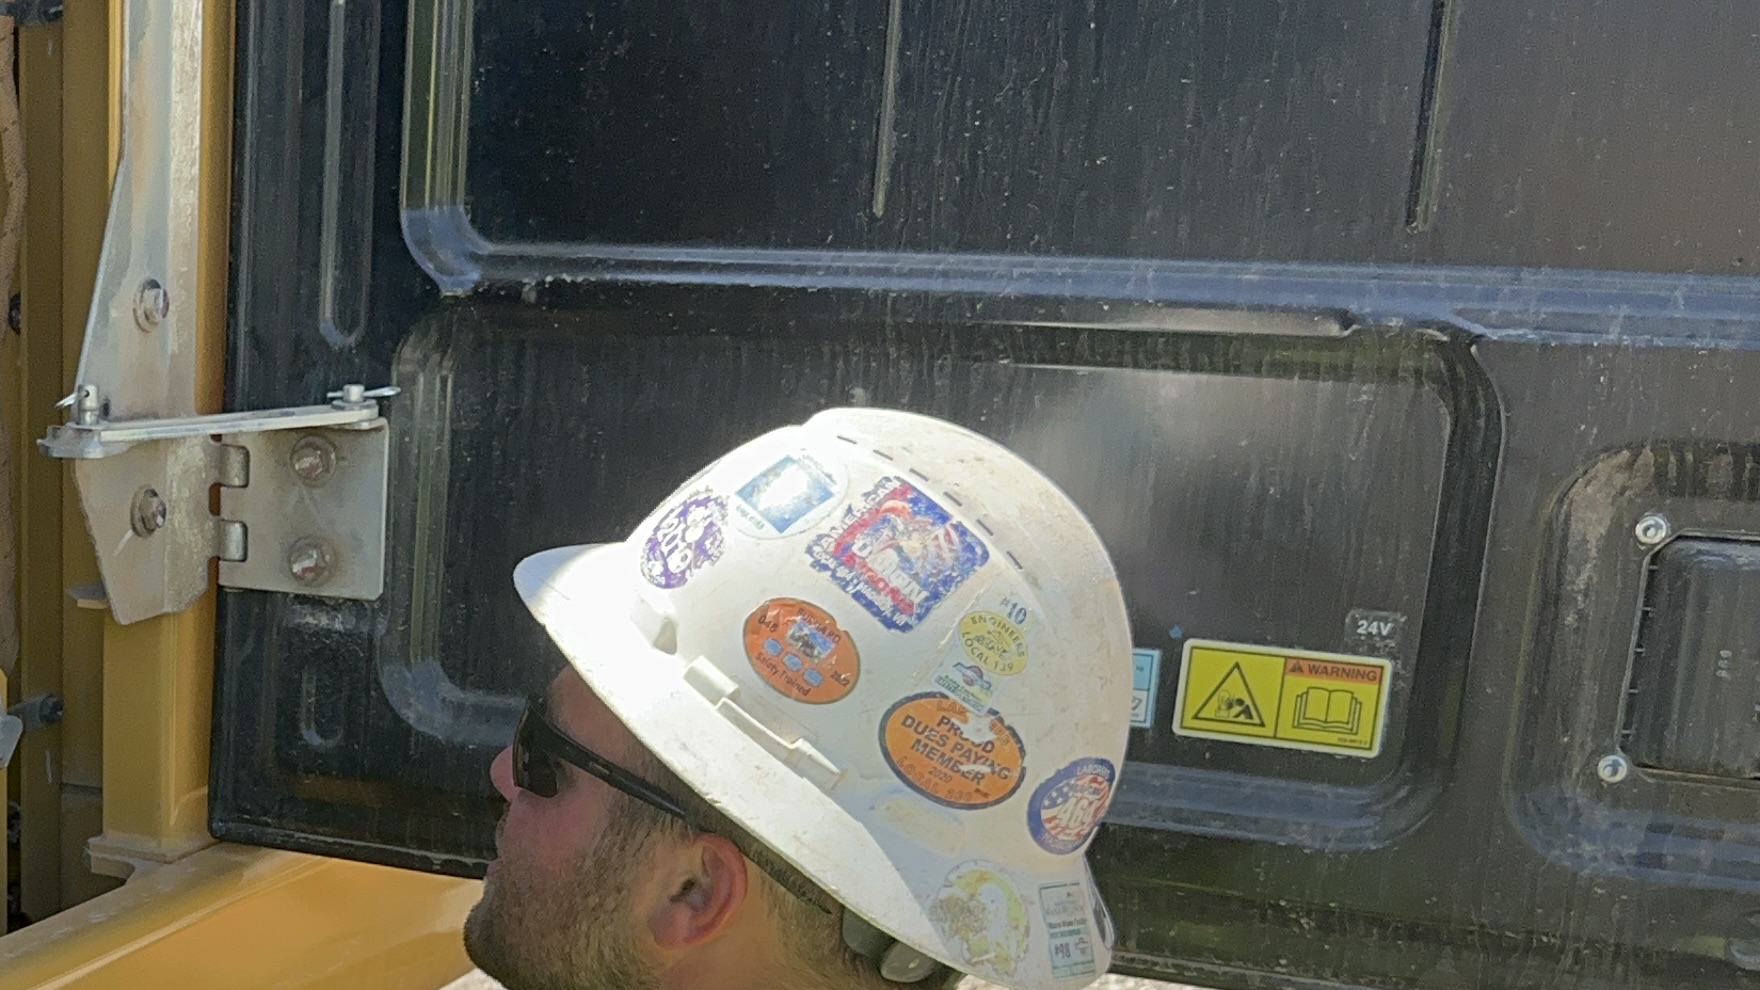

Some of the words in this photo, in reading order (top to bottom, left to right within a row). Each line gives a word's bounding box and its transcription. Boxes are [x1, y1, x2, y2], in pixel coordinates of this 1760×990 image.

[970, 615, 1025, 658] ENGINEERS
[1356, 619, 1393, 637] 24V
[755, 652, 780, 676] Safety
[961, 631, 989, 665] LOCAL
[994, 660, 1014, 672] 139
[780, 670, 812, 697] Trained
[1308, 663, 1377, 682] WARNING
[900, 714, 949, 748] DUES
[950, 741, 1012, 780] PAYING
[909, 738, 986, 786] MEMBER
[896, 756, 940, 796] LOCAL
[928, 765, 953, 784] 2020
